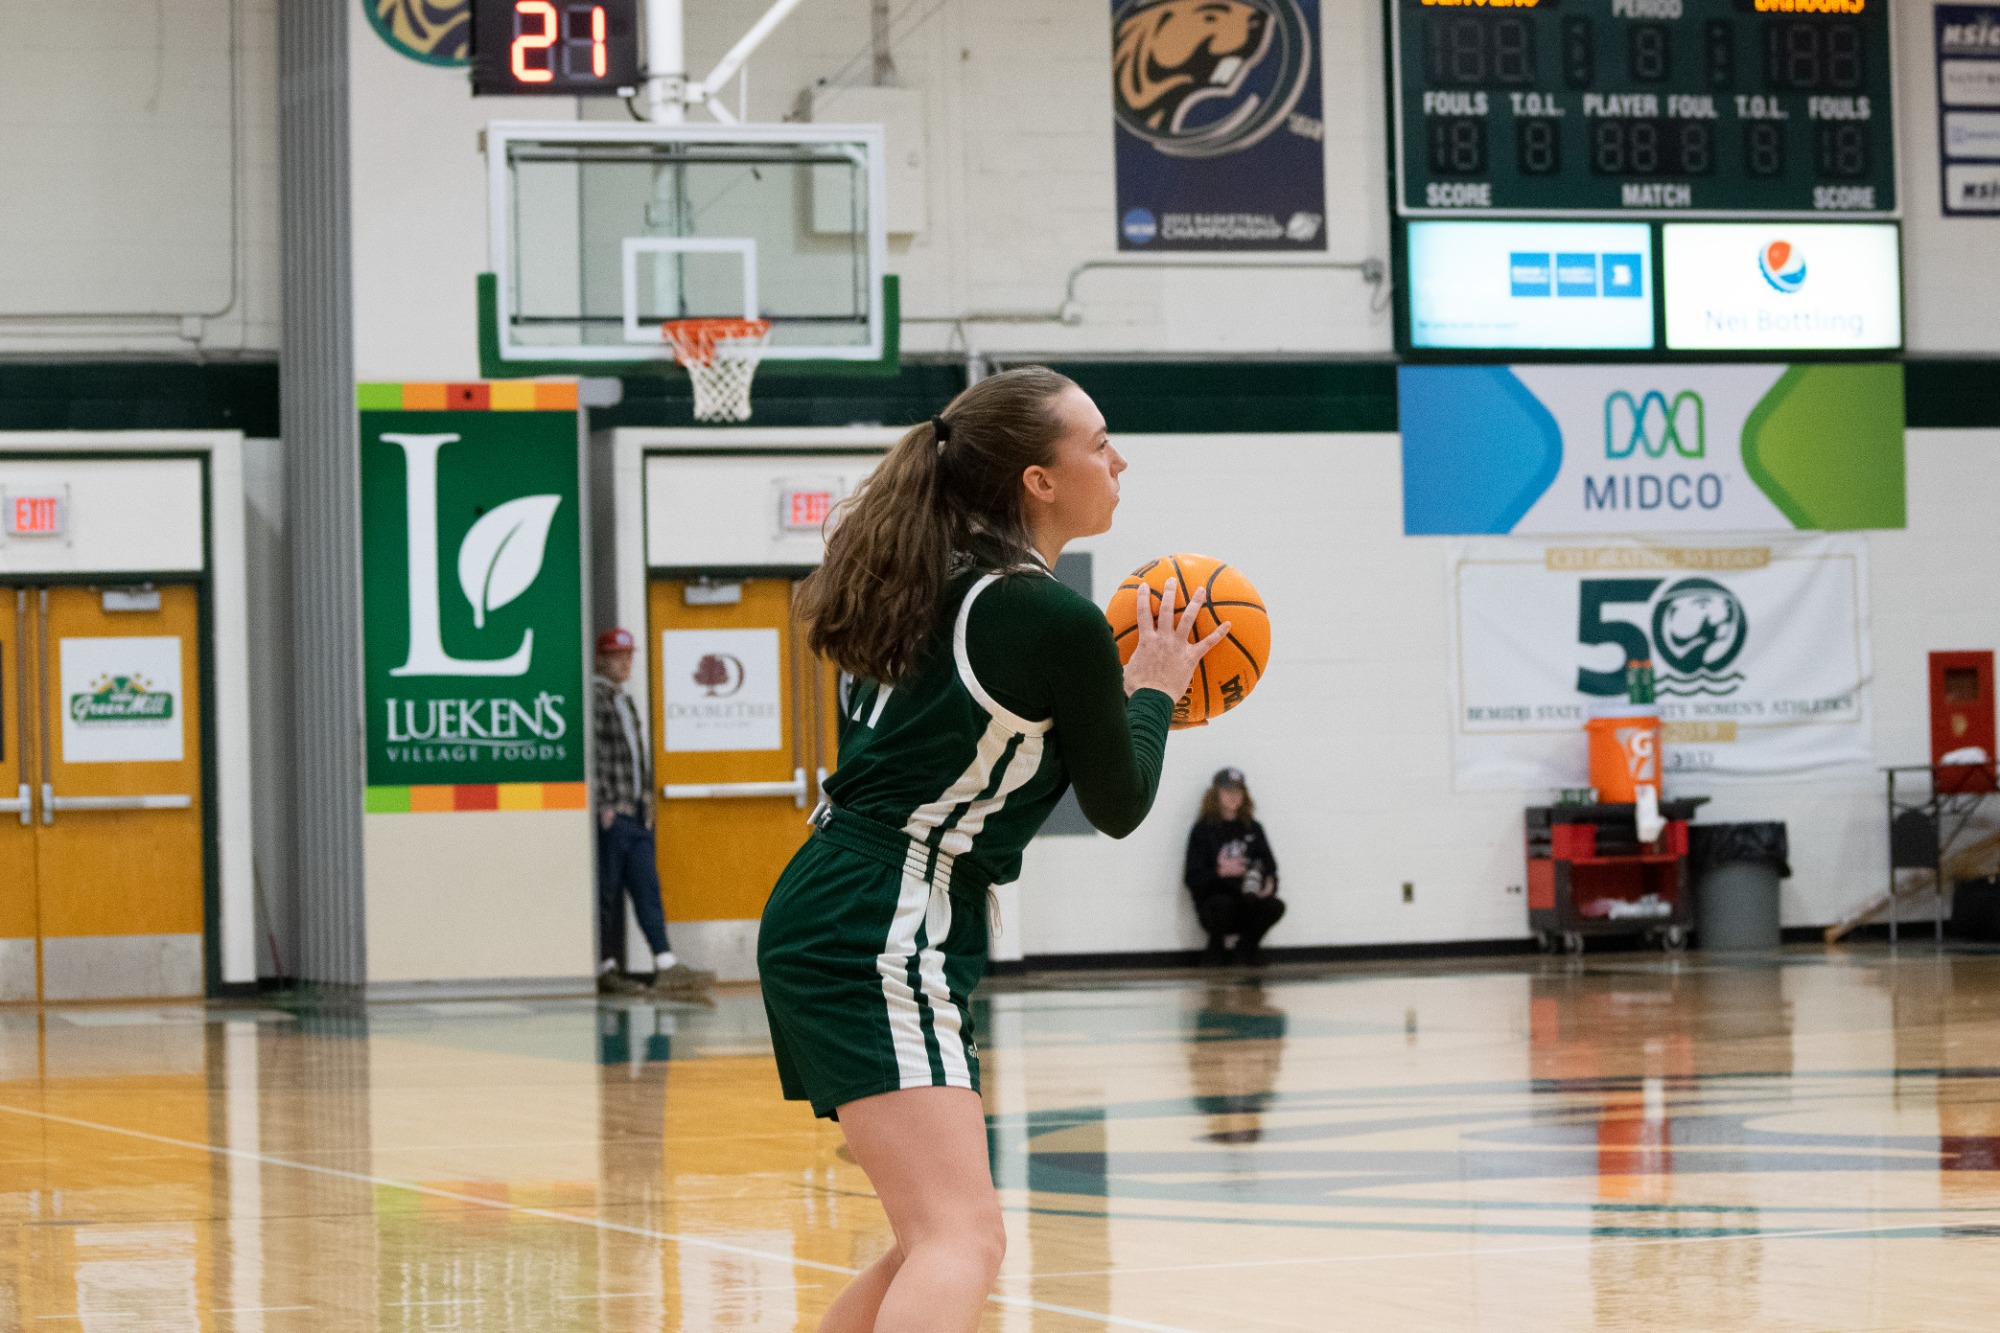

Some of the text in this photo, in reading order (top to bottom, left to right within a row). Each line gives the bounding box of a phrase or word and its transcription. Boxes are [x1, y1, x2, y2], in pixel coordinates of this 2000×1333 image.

[511, 0, 607, 83] 21
[1424, 92, 1488, 116] FOULS
[1511, 92, 1565, 117] T.O.L.
[1584, 94, 1718, 118] PLAYER FOUL
[1735, 95, 1788, 119] T.O.L.
[1808, 96, 1871, 120] FOULS
[1426, 183, 1491, 207] SCORE
[1622, 183, 1692, 207] MATCH
[1813, 186, 1875, 210] SCORE
[1757, 309, 1864, 338] Bottling
[1584, 473, 1723, 511] MIDCO
[15, 496, 57, 532] EXIT
[386, 690, 567, 743] LUEKEN'S
[1537, 704, 1582, 719] STATE
[386, 745, 567, 763] VILLAGE FOODS
